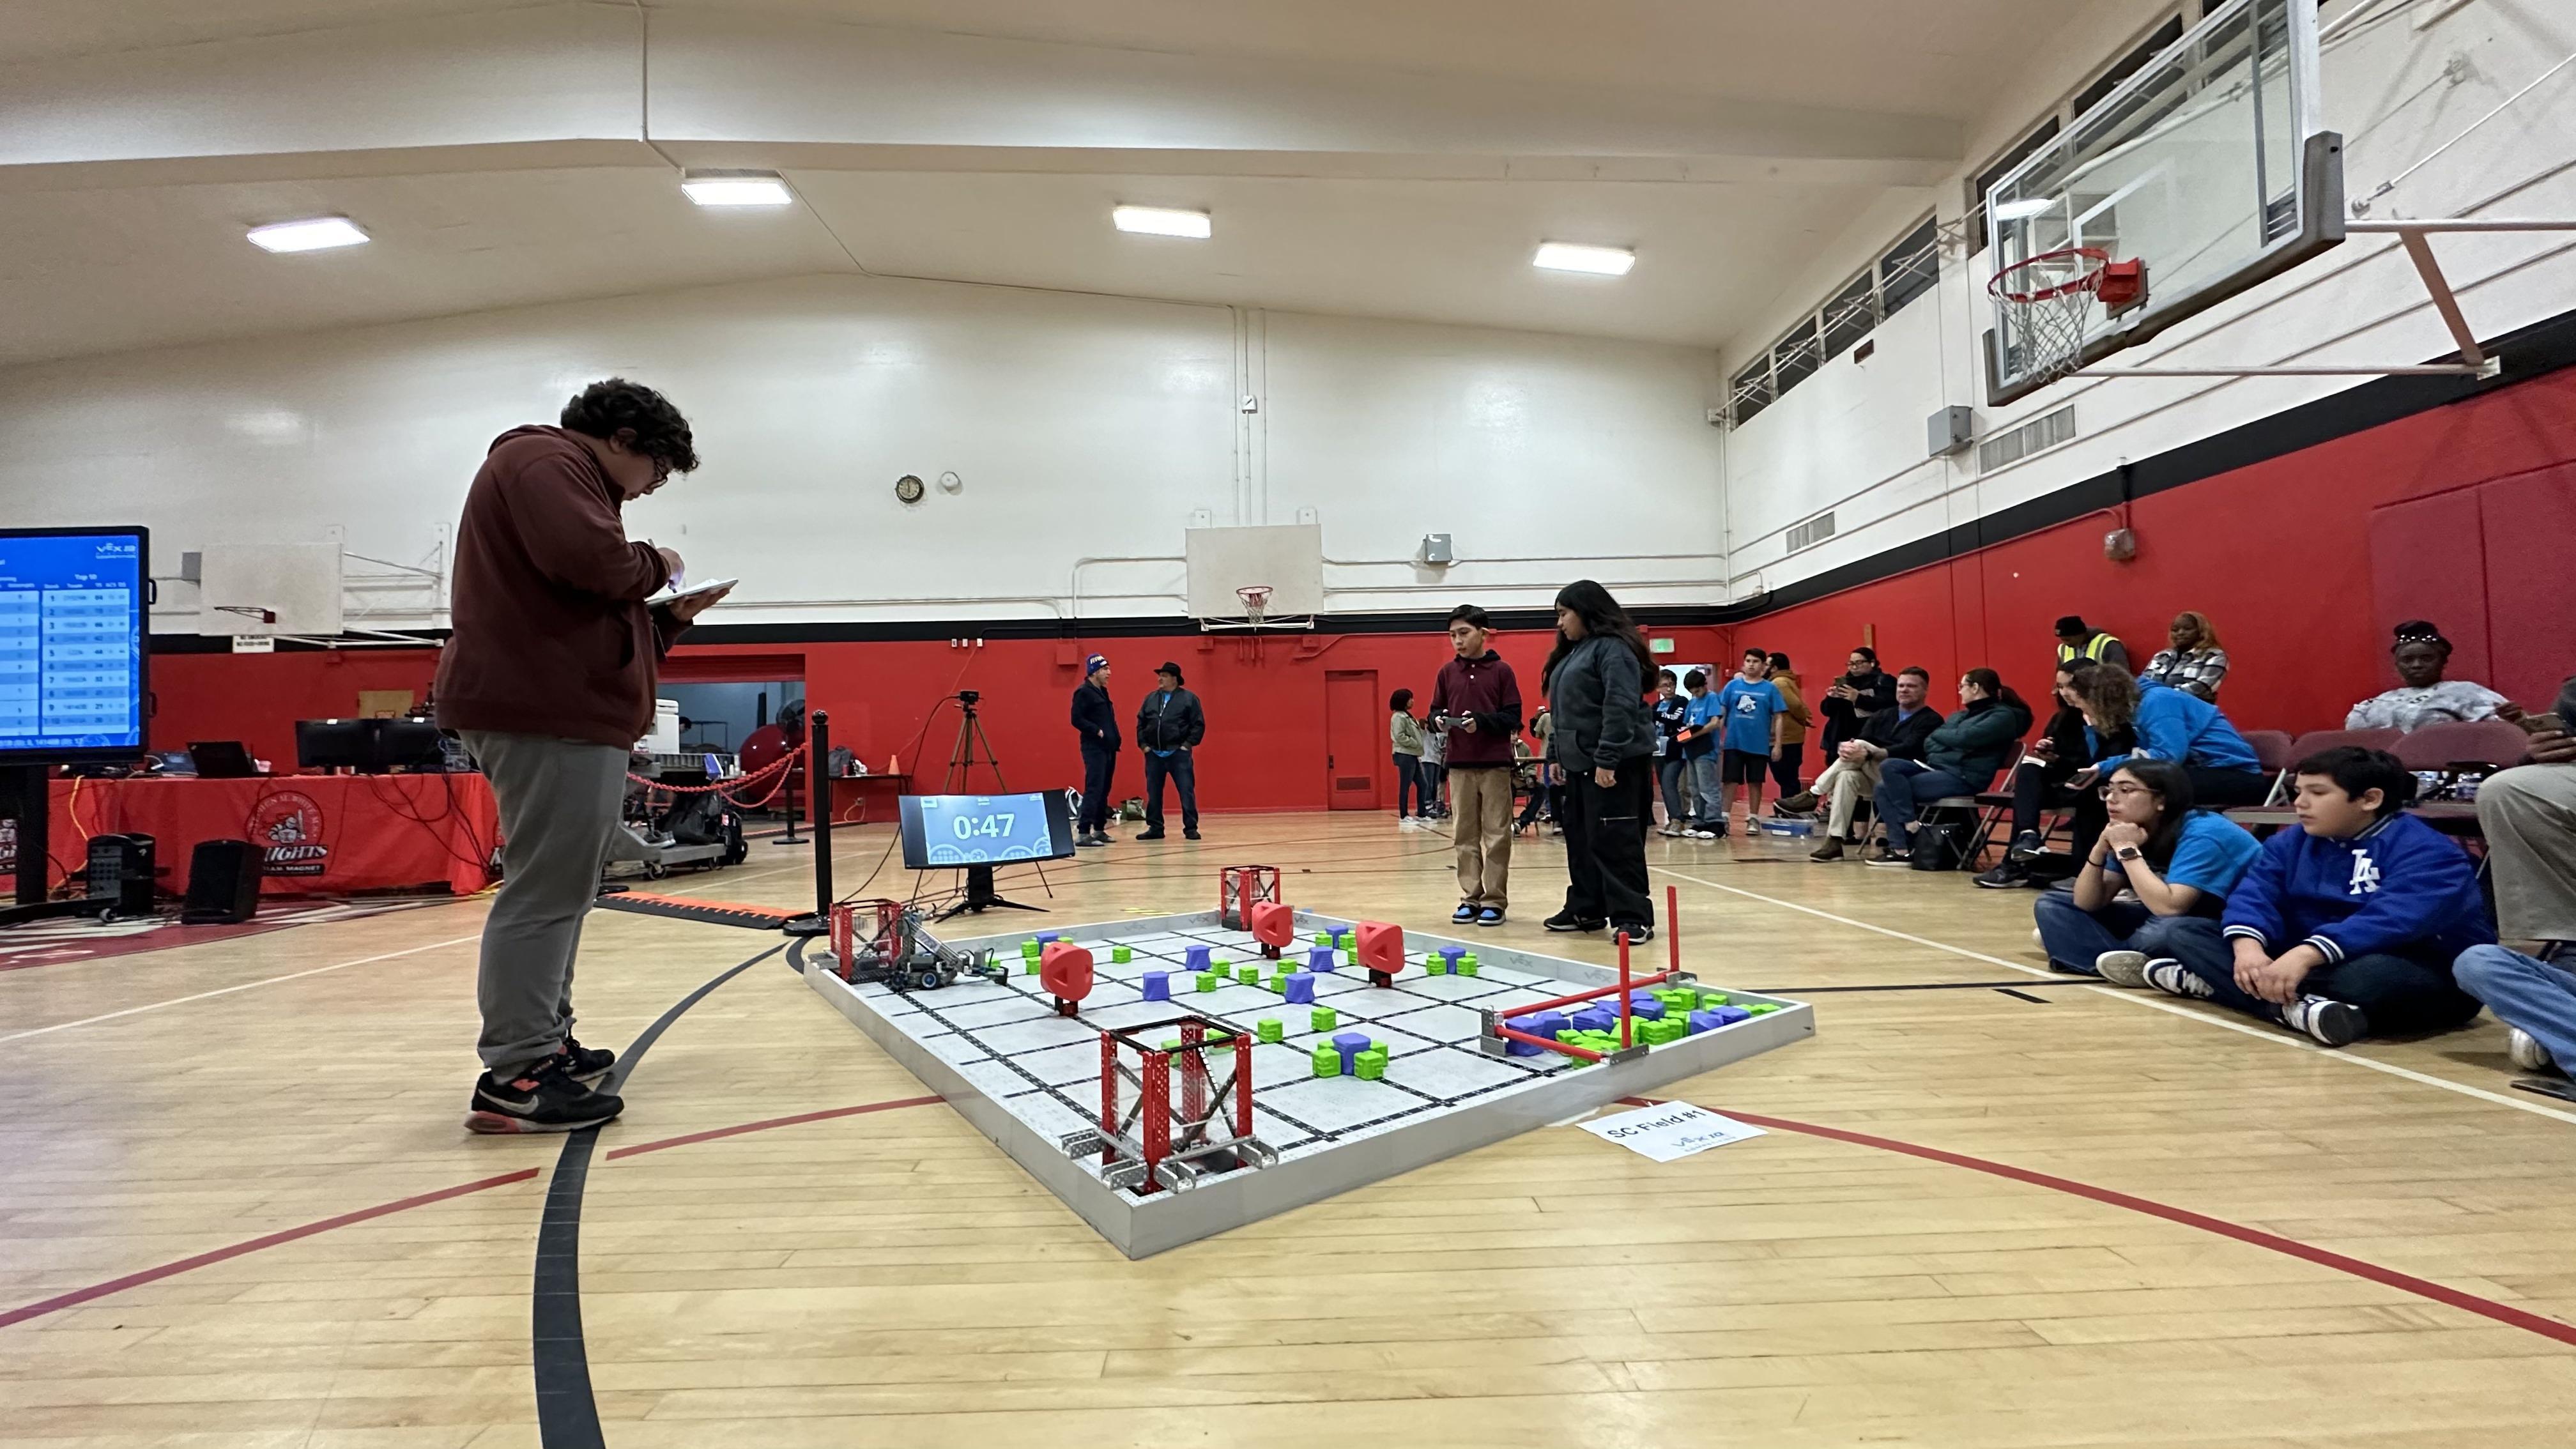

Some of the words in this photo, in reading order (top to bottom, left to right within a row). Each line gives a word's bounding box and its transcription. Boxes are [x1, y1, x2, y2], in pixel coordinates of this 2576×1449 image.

[953, 813, 1015, 840] 0:47
[264, 845, 328, 862] IGHTS
[2349, 848, 2381, 896] LA
[1508, 954, 1533, 968] VEX
[1584, 969, 1613, 984] VEX
[1607, 1127, 1639, 1138] SC
[1636, 1114, 1686, 1131] Field
[1681, 1109, 1707, 1120] #1
